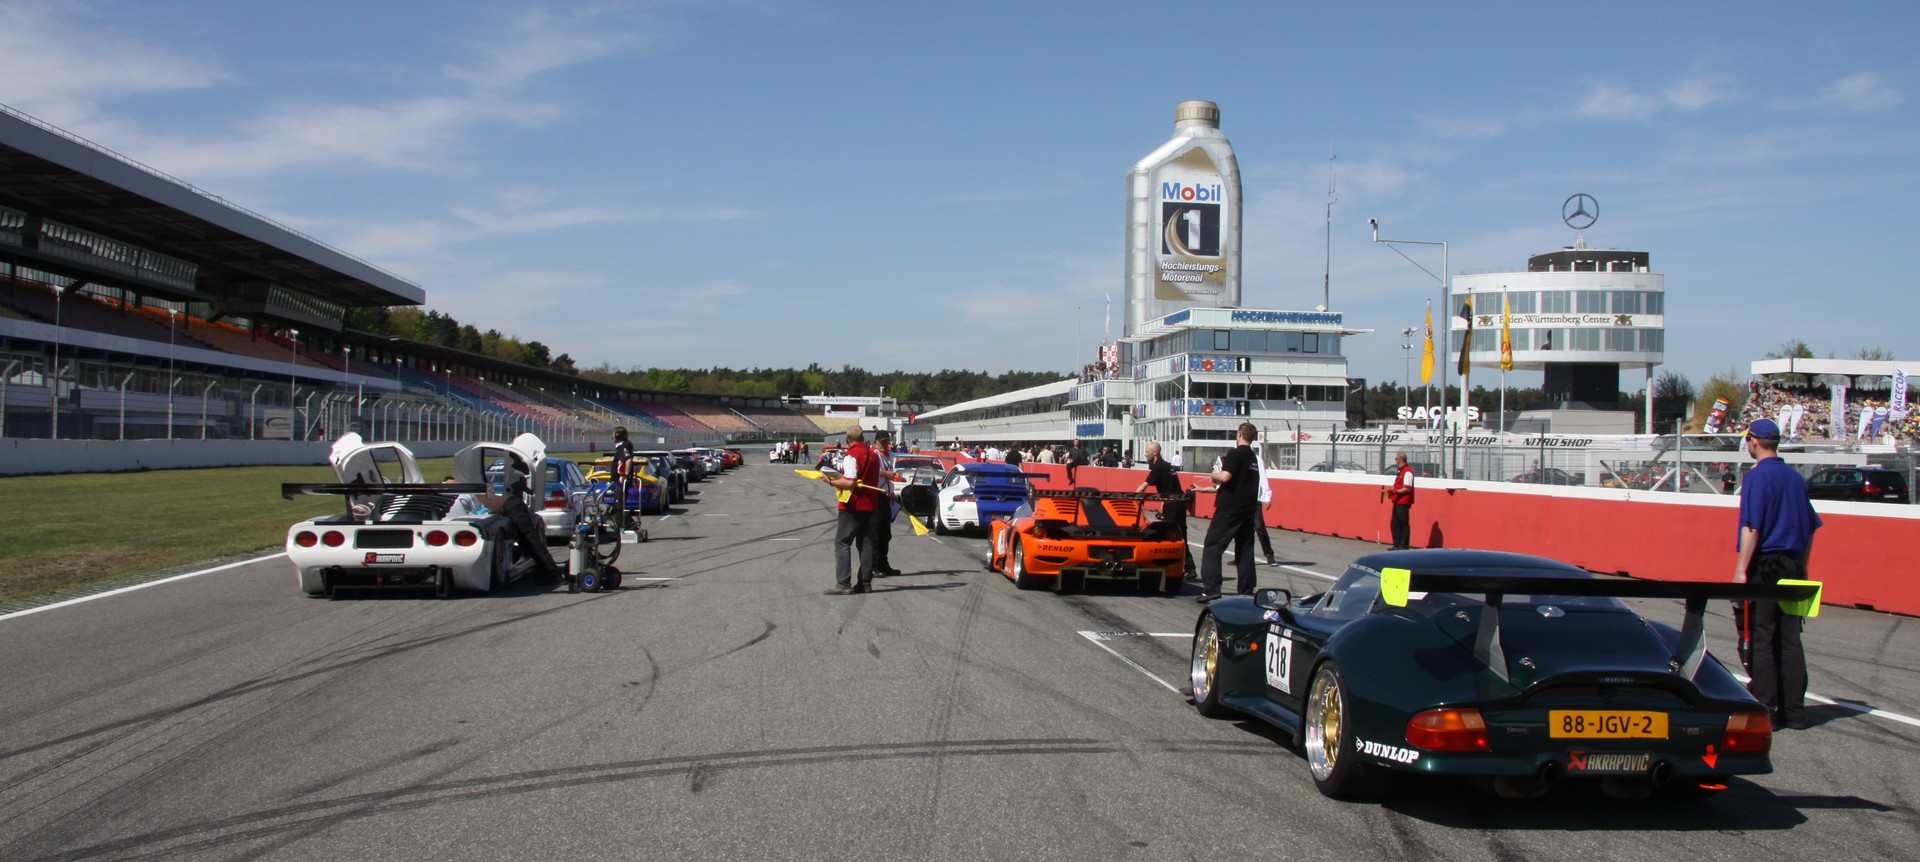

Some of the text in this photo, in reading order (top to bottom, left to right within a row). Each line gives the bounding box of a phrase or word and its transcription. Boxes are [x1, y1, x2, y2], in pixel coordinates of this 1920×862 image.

[1162, 182, 1221, 201] Mobil
[1183, 209, 1201, 250] 1
[1161, 261, 1223, 273] Hochleistungs-
[1161, 273, 1204, 283] Motorenöl
[1582, 315, 1611, 324] Center
[1188, 356, 1234, 371] Mobil
[1893, 368, 1904, 412] RACECOM
[1188, 399, 1234, 415] Mobil
[1365, 434, 1399, 443] SHOP
[1464, 436, 1497, 445] SHOP
[1559, 438, 1593, 447] SHOP
[1268, 641, 1287, 679] 218
[1562, 715, 1653, 734] 88-JGV-2
[1363, 740, 1420, 764] DUNLOP
